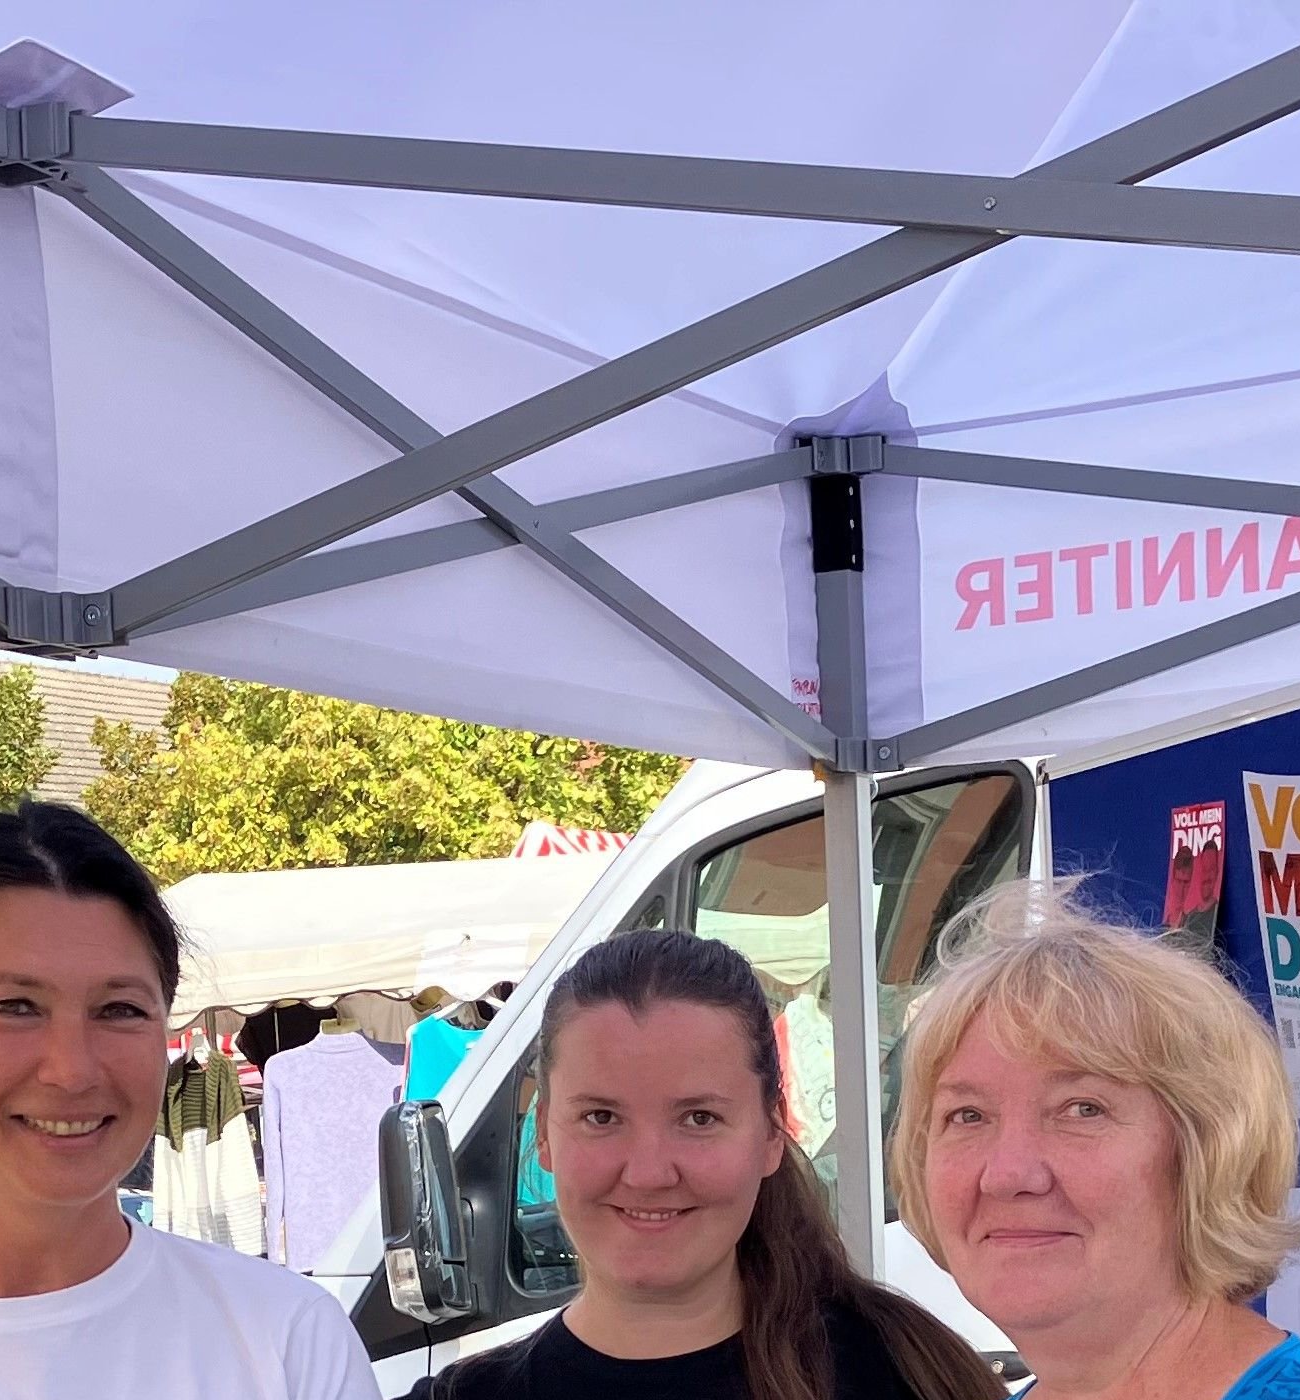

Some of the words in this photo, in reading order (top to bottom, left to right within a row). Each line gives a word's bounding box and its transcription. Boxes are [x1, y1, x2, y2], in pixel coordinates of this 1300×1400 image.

[1174, 811, 1198, 828] VOLL
[1199, 808, 1222, 825] MEIN
[1173, 824, 1222, 860] DING
